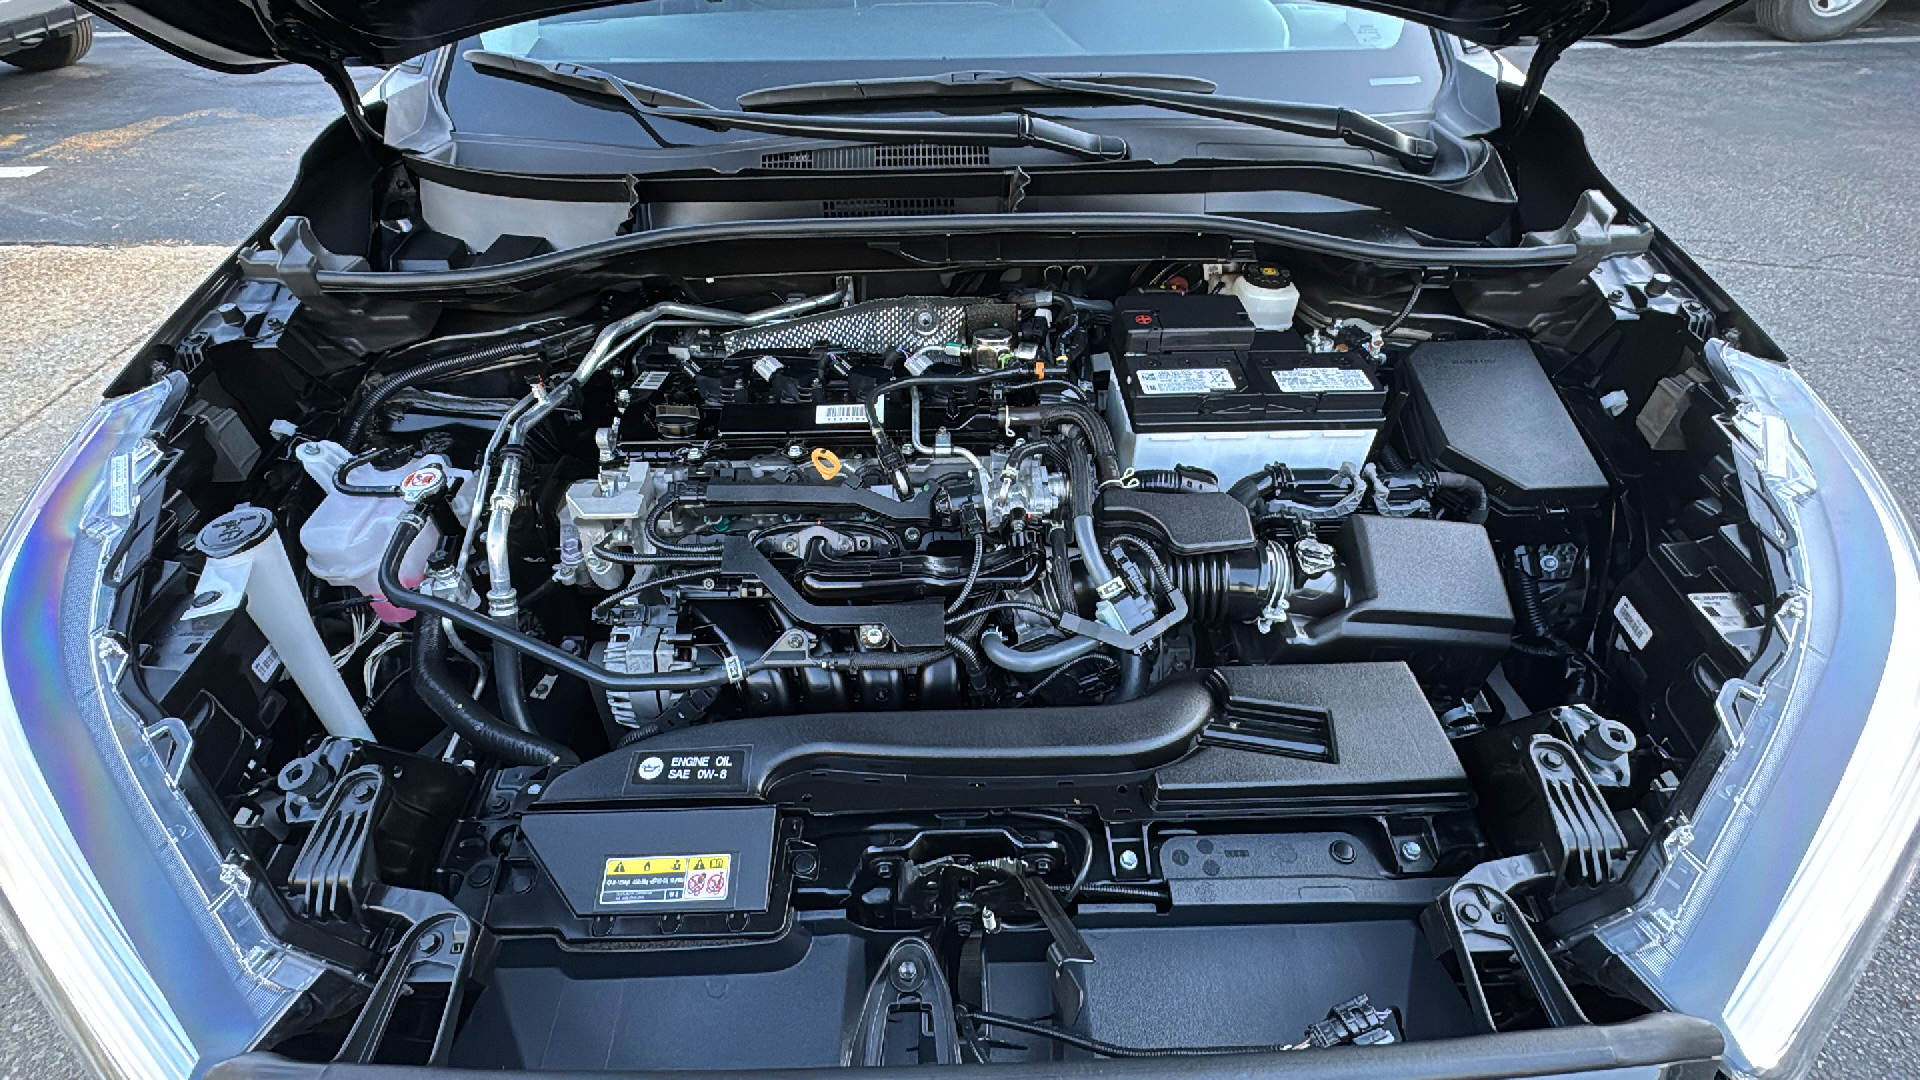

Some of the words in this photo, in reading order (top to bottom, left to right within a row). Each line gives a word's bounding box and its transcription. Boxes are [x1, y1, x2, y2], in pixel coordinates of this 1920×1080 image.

[671, 756, 710, 767] ENGINE
[715, 755, 733, 767] OIL
[667, 769, 691, 779] SAE
[697, 769, 728, 779] 0W-8
